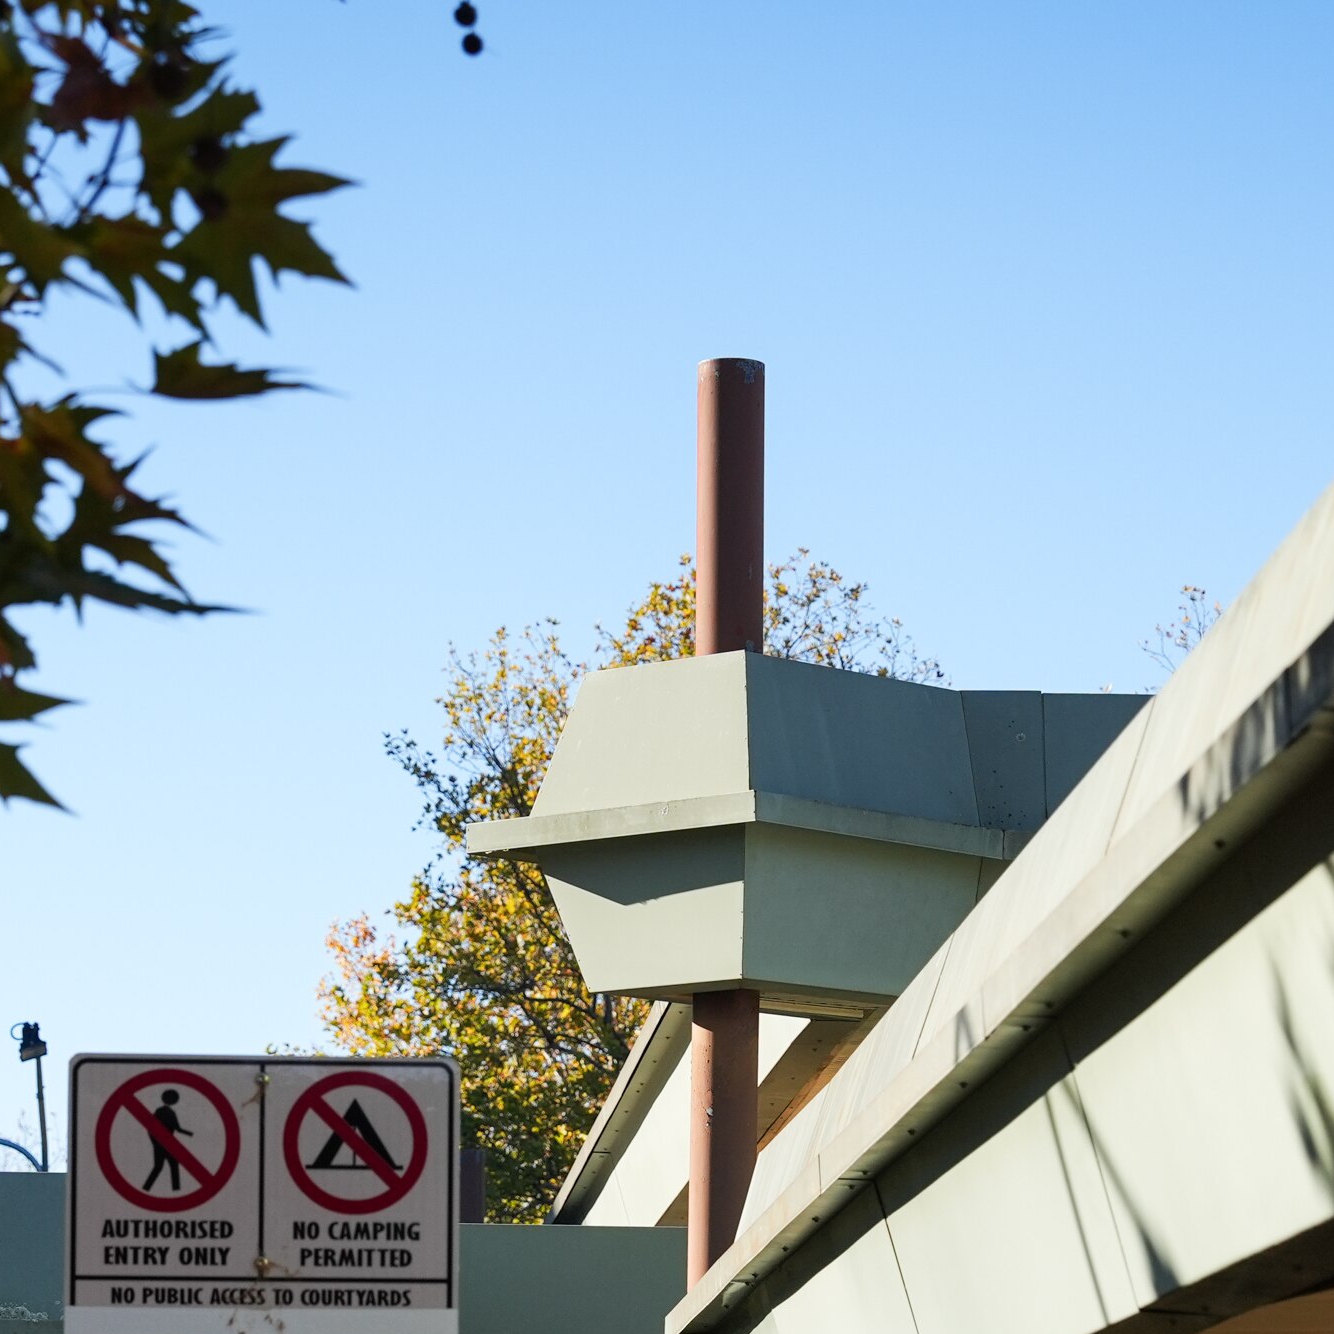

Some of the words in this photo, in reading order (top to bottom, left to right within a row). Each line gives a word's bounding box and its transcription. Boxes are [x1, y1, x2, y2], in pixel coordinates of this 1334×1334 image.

[102, 1219, 233, 1239] AUTHORISED
[293, 1222, 319, 1240] NO
[328, 1222, 420, 1241] CAMPING
[104, 1246, 169, 1265] ENTRY
[179, 1247, 230, 1265] ONLY
[300, 1248, 412, 1267] PERMITTED
[111, 1287, 135, 1304] NO
[142, 1287, 203, 1305] PUBLIC
[210, 1288, 265, 1305] ACCESS
[273, 1289, 293, 1305] TO
[301, 1289, 411, 1306] COURTYARDS
